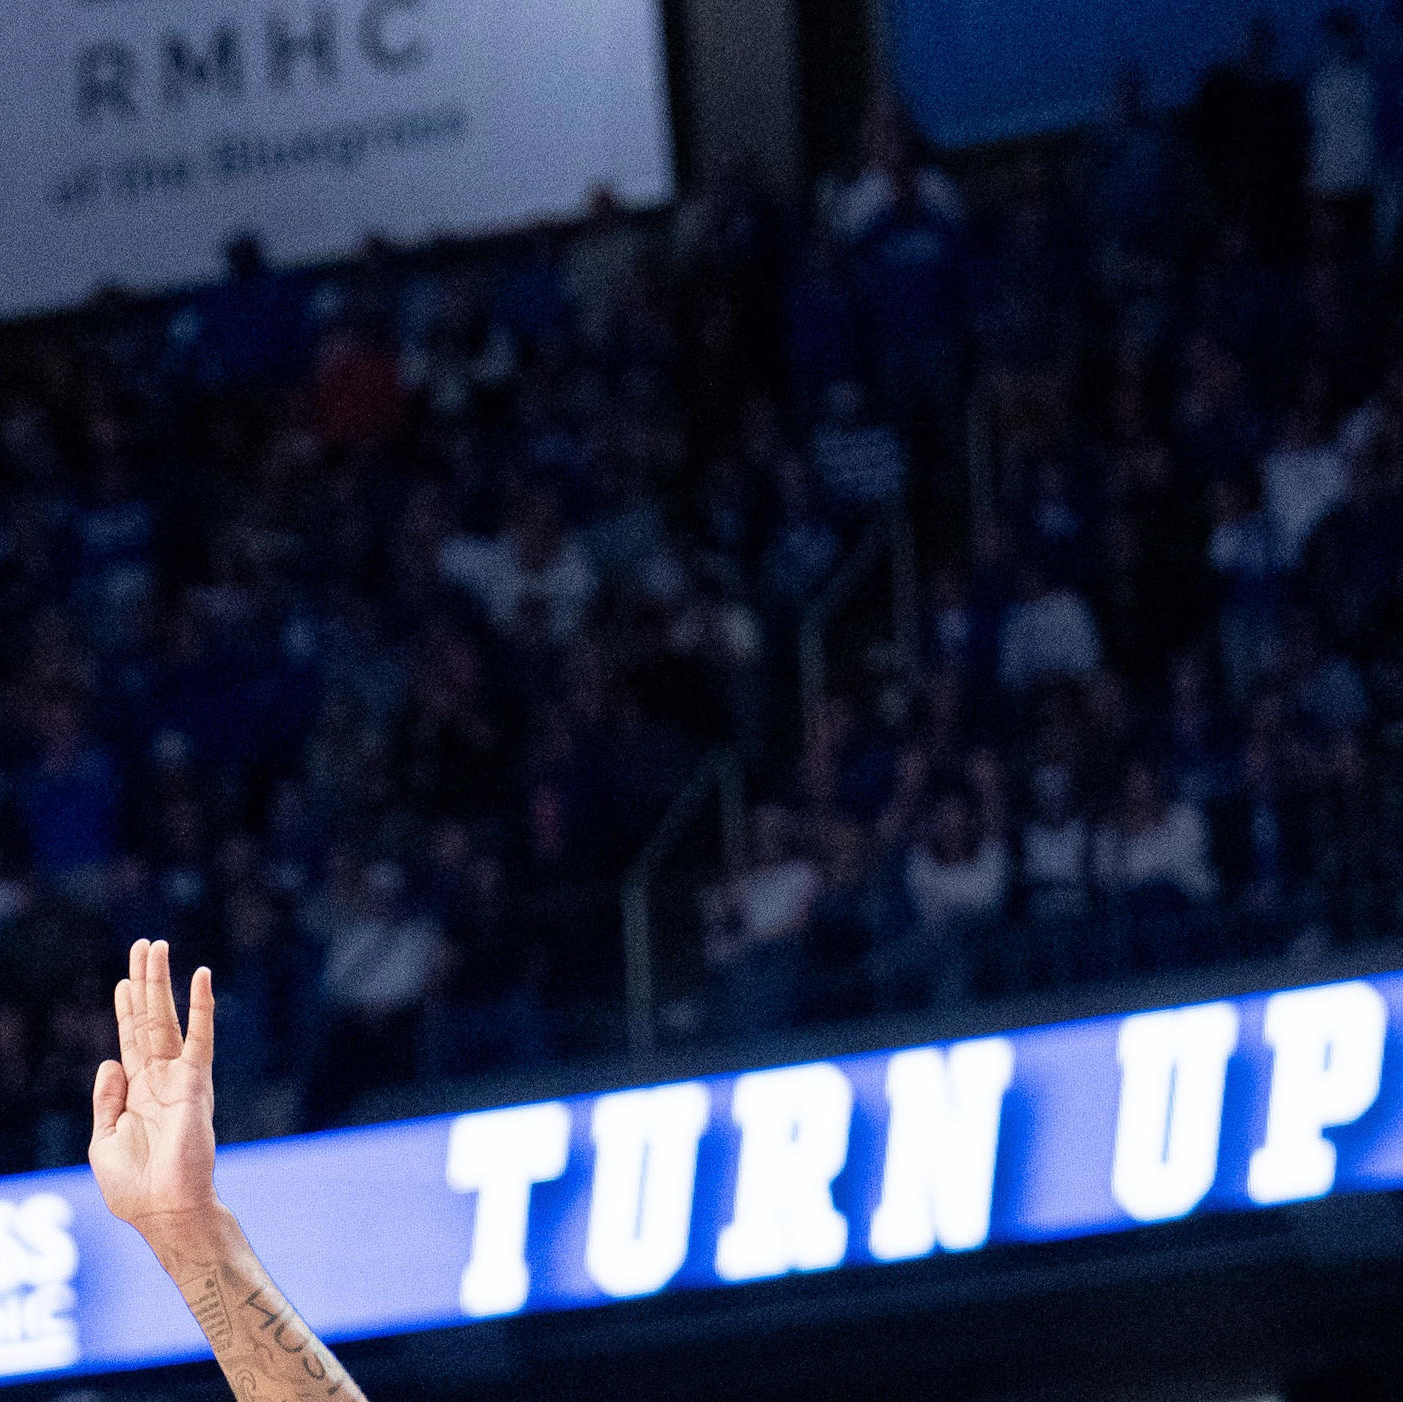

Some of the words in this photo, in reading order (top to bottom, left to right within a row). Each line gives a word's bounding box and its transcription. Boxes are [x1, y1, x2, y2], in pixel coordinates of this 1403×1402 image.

[71, 0, 433, 124] RMHC
[446, 1035, 1016, 1319] TURN
[1112, 980, 1388, 1222] UP
